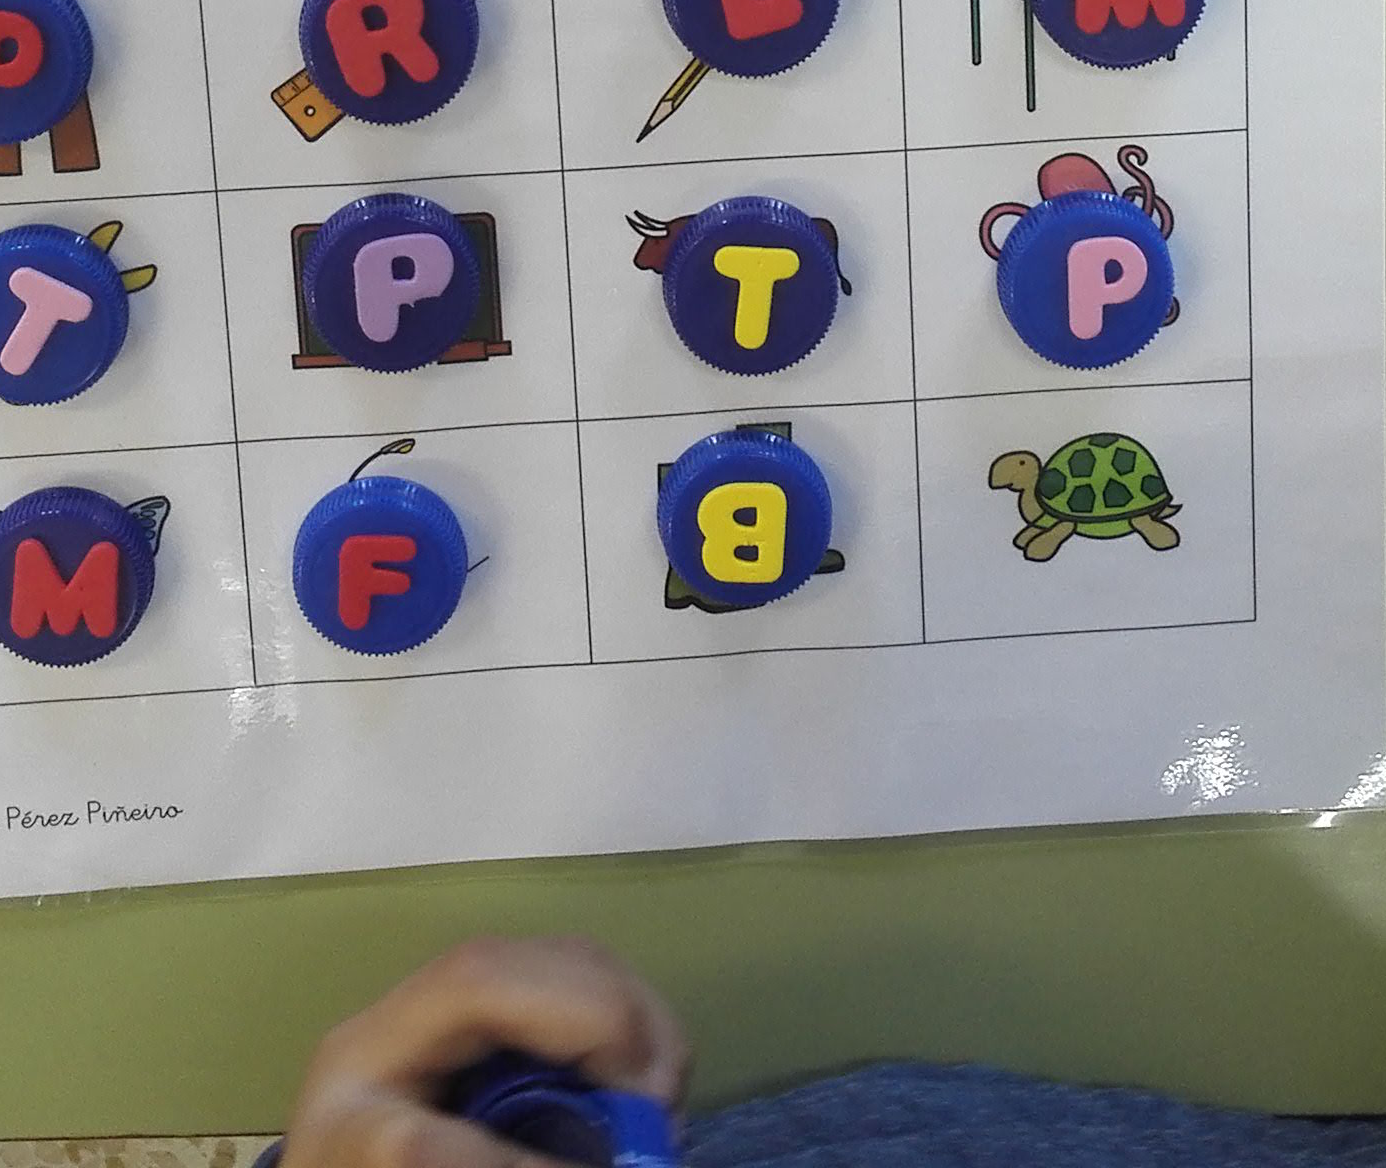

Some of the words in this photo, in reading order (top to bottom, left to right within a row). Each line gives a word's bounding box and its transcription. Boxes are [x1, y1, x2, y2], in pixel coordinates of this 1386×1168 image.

[0, 267, 92, 375] T
[353, 233, 453, 342] P
[714, 246, 799, 349] T
[1067, 236, 1147, 339] P
[338, 535, 416, 629] F
[697, 482, 787, 583] B
[10, 539, 118, 639] M
[6, 805, 80, 831] Pérez
[86, 799, 185, 825] Piñeiro
